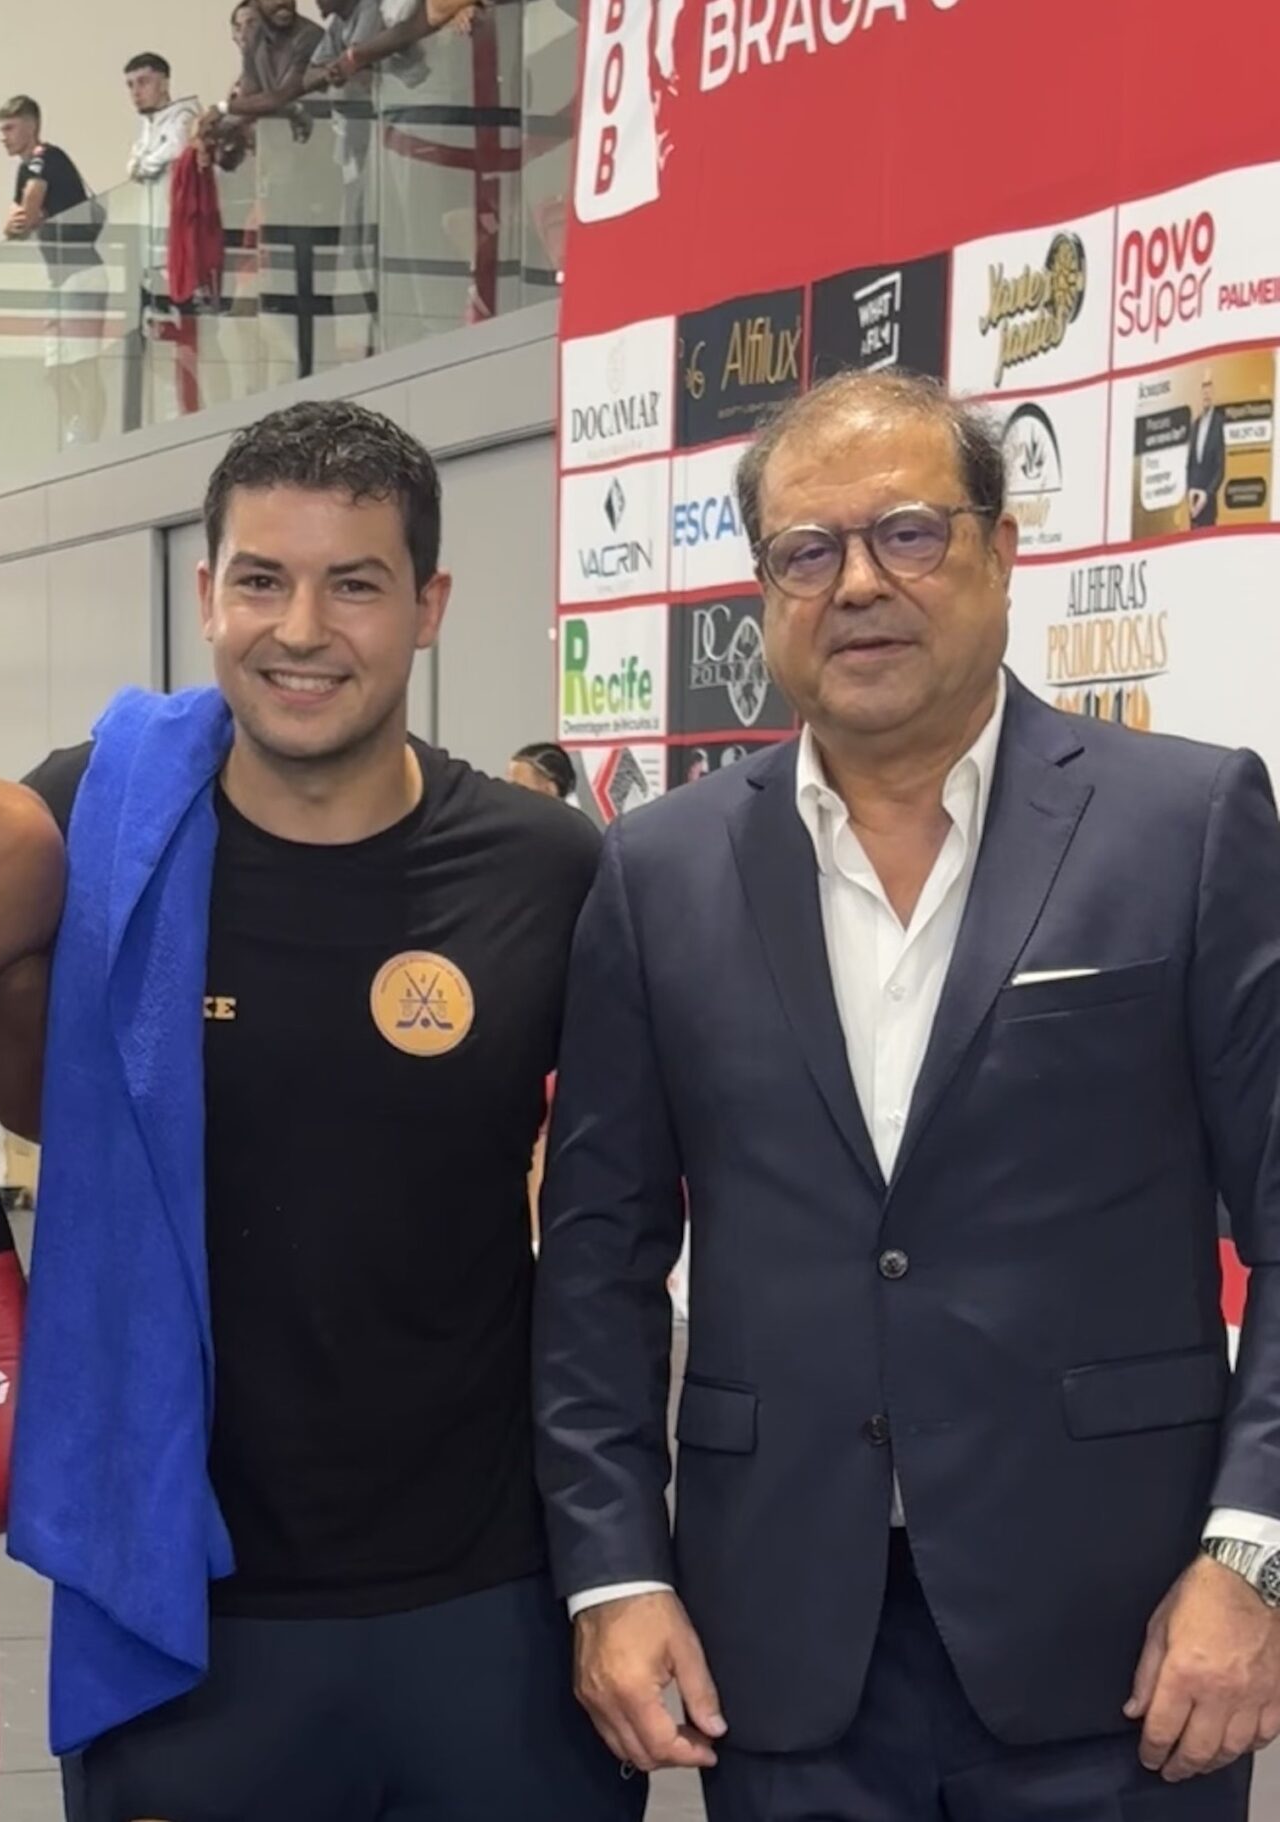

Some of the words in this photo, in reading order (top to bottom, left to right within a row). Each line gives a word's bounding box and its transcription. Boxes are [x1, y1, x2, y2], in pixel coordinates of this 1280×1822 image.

[1122, 211, 1215, 298] novo
[1118, 267, 1211, 343] super
[571, 391, 661, 443] DOCAMAR
[673, 495, 744, 547] ESCA
[1067, 560, 1148, 617] ALHEIRAS
[564, 618, 652, 716] Recife
[1047, 611, 1168, 680] PRIMOROSAS
